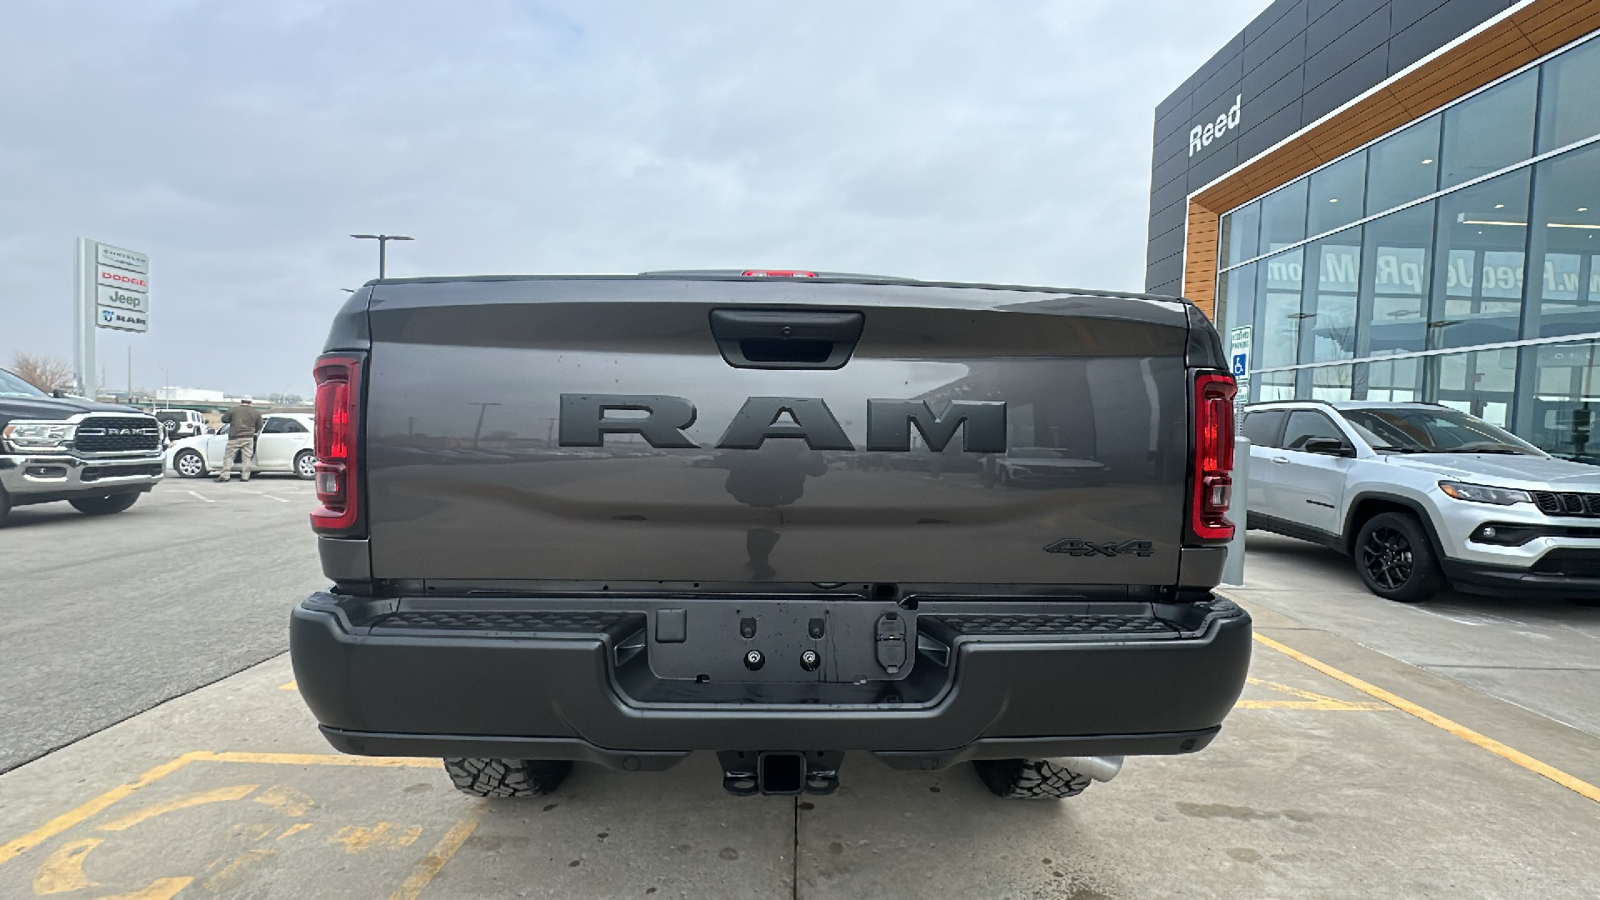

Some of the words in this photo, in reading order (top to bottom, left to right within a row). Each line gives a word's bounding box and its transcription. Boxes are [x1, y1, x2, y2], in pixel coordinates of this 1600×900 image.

[1189, 93, 1242, 157] Reed
[102, 272, 146, 287] DODGE
[110, 291, 141, 308] Jeep
[116, 315, 146, 325] RAM
[559, 393, 1007, 452] RAM
[107, 428, 143, 436] RAM
